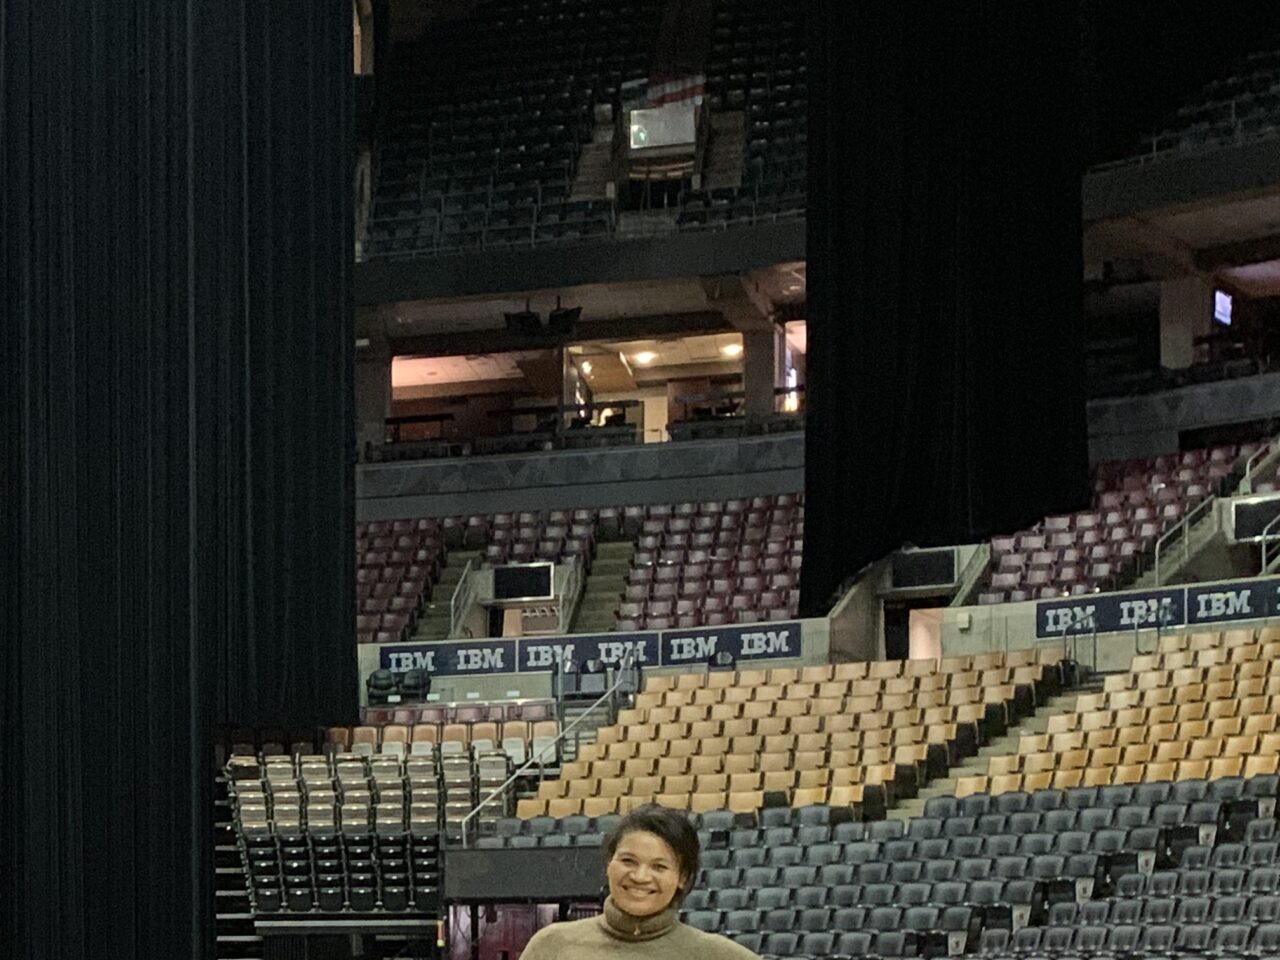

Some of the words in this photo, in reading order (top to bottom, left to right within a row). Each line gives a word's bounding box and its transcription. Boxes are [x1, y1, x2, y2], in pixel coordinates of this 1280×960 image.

[1197, 590, 1251, 618] IBM
[1045, 605, 1096, 632] IBM
[670, 636, 718, 660] IBM
[741, 631, 790, 655] IBM
[389, 651, 435, 673] IBM
[456, 648, 504, 670] IBM
